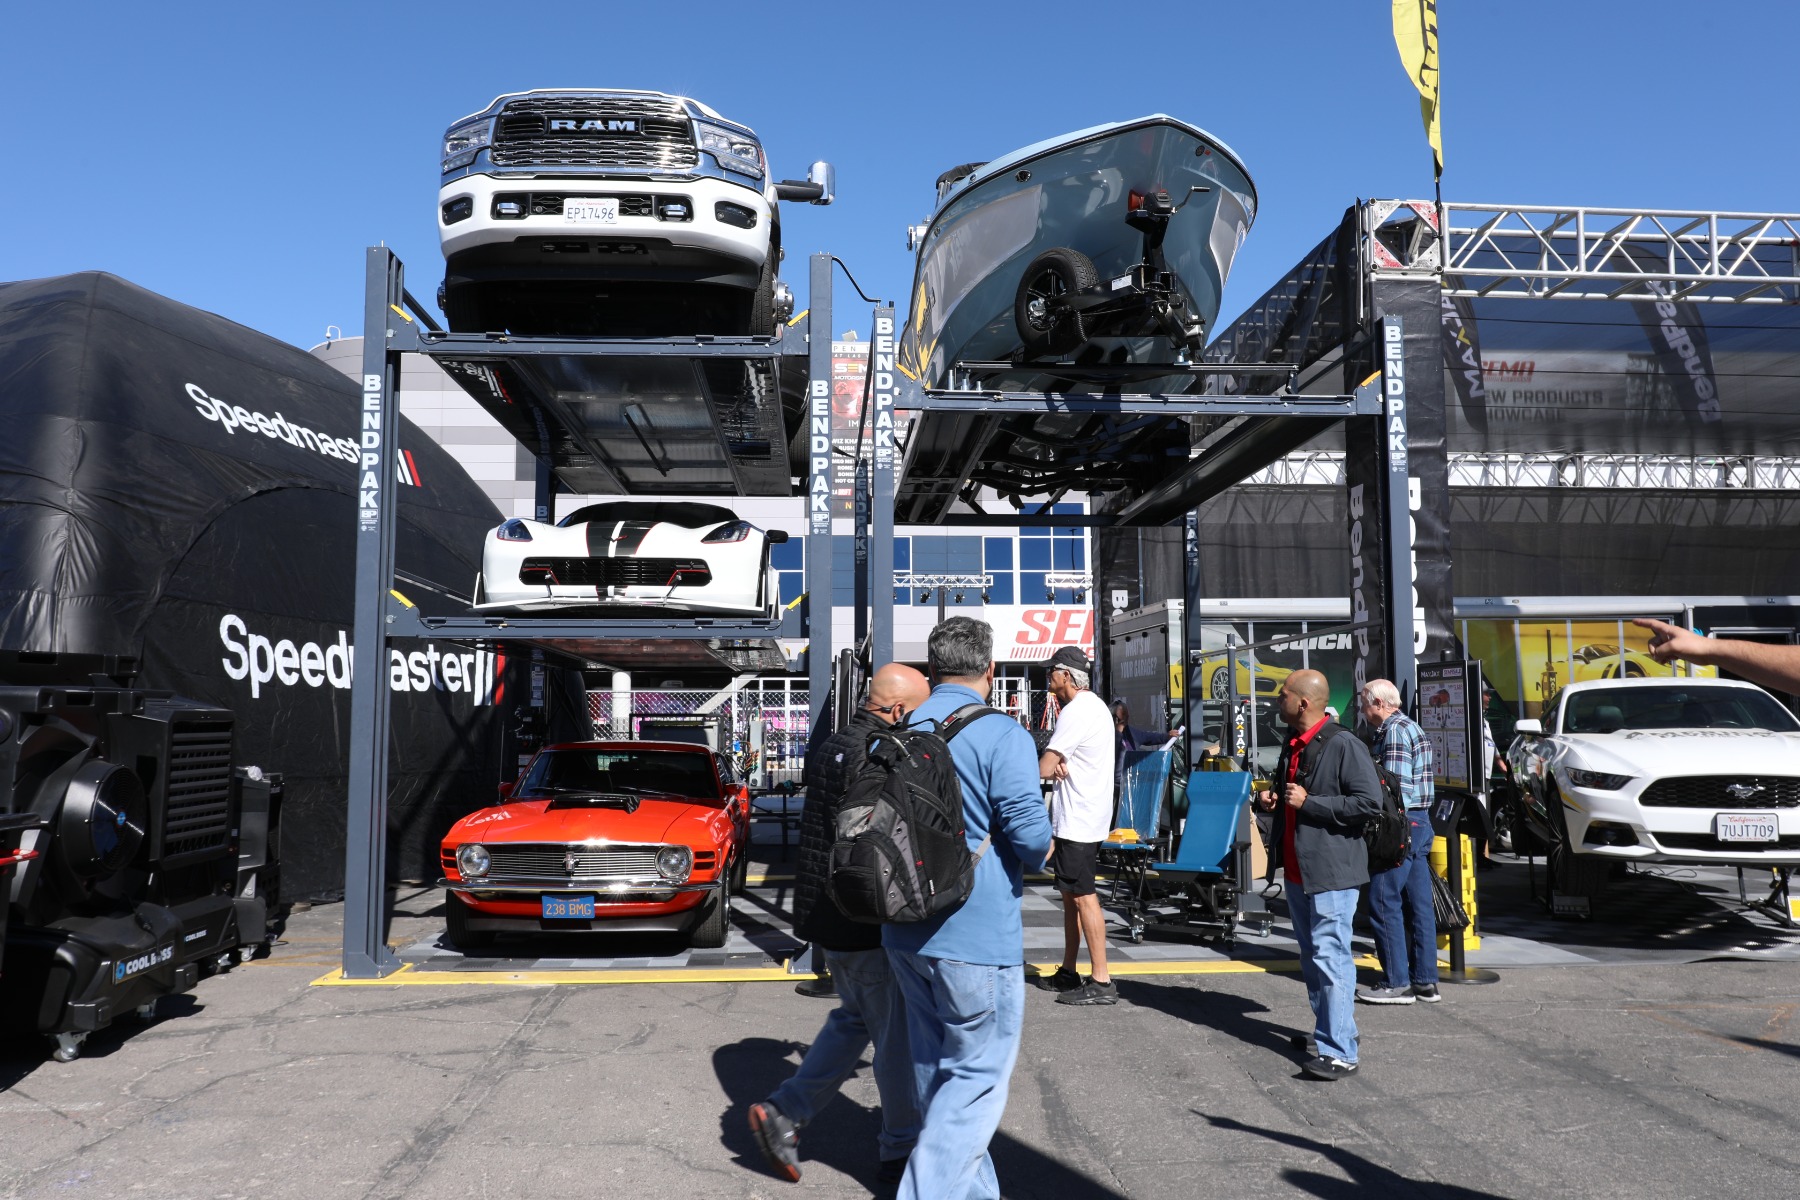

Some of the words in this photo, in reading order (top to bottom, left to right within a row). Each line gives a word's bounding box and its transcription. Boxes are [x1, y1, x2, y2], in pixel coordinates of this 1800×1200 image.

[551, 119, 635, 131] RAM
[567, 207, 614, 219] EP17496
[1441, 281, 1485, 398] MAXJA
[834, 363, 867, 373] SEM
[875, 317, 893, 447] BENDPAK
[1385, 325, 1406, 451] BENDPAK
[1513, 390, 1603, 405] PRODUCTS
[185, 383, 361, 464] Speedmast
[360, 374, 382, 508] BENDPAK
[812, 380, 829, 511] BENDPAK
[855, 466, 867, 550] BENDPAK
[1015, 609, 1094, 645] SE
[219, 614, 474, 698] Speedaster
[1234, 705, 1246, 754] MAXJAX
[1722, 824, 1774, 837] 7UJT709
[546, 904, 565, 915] 238
[569, 904, 591, 915] BMG
[126, 955, 150, 974] COOL
[151, 945, 174, 963] BSS
